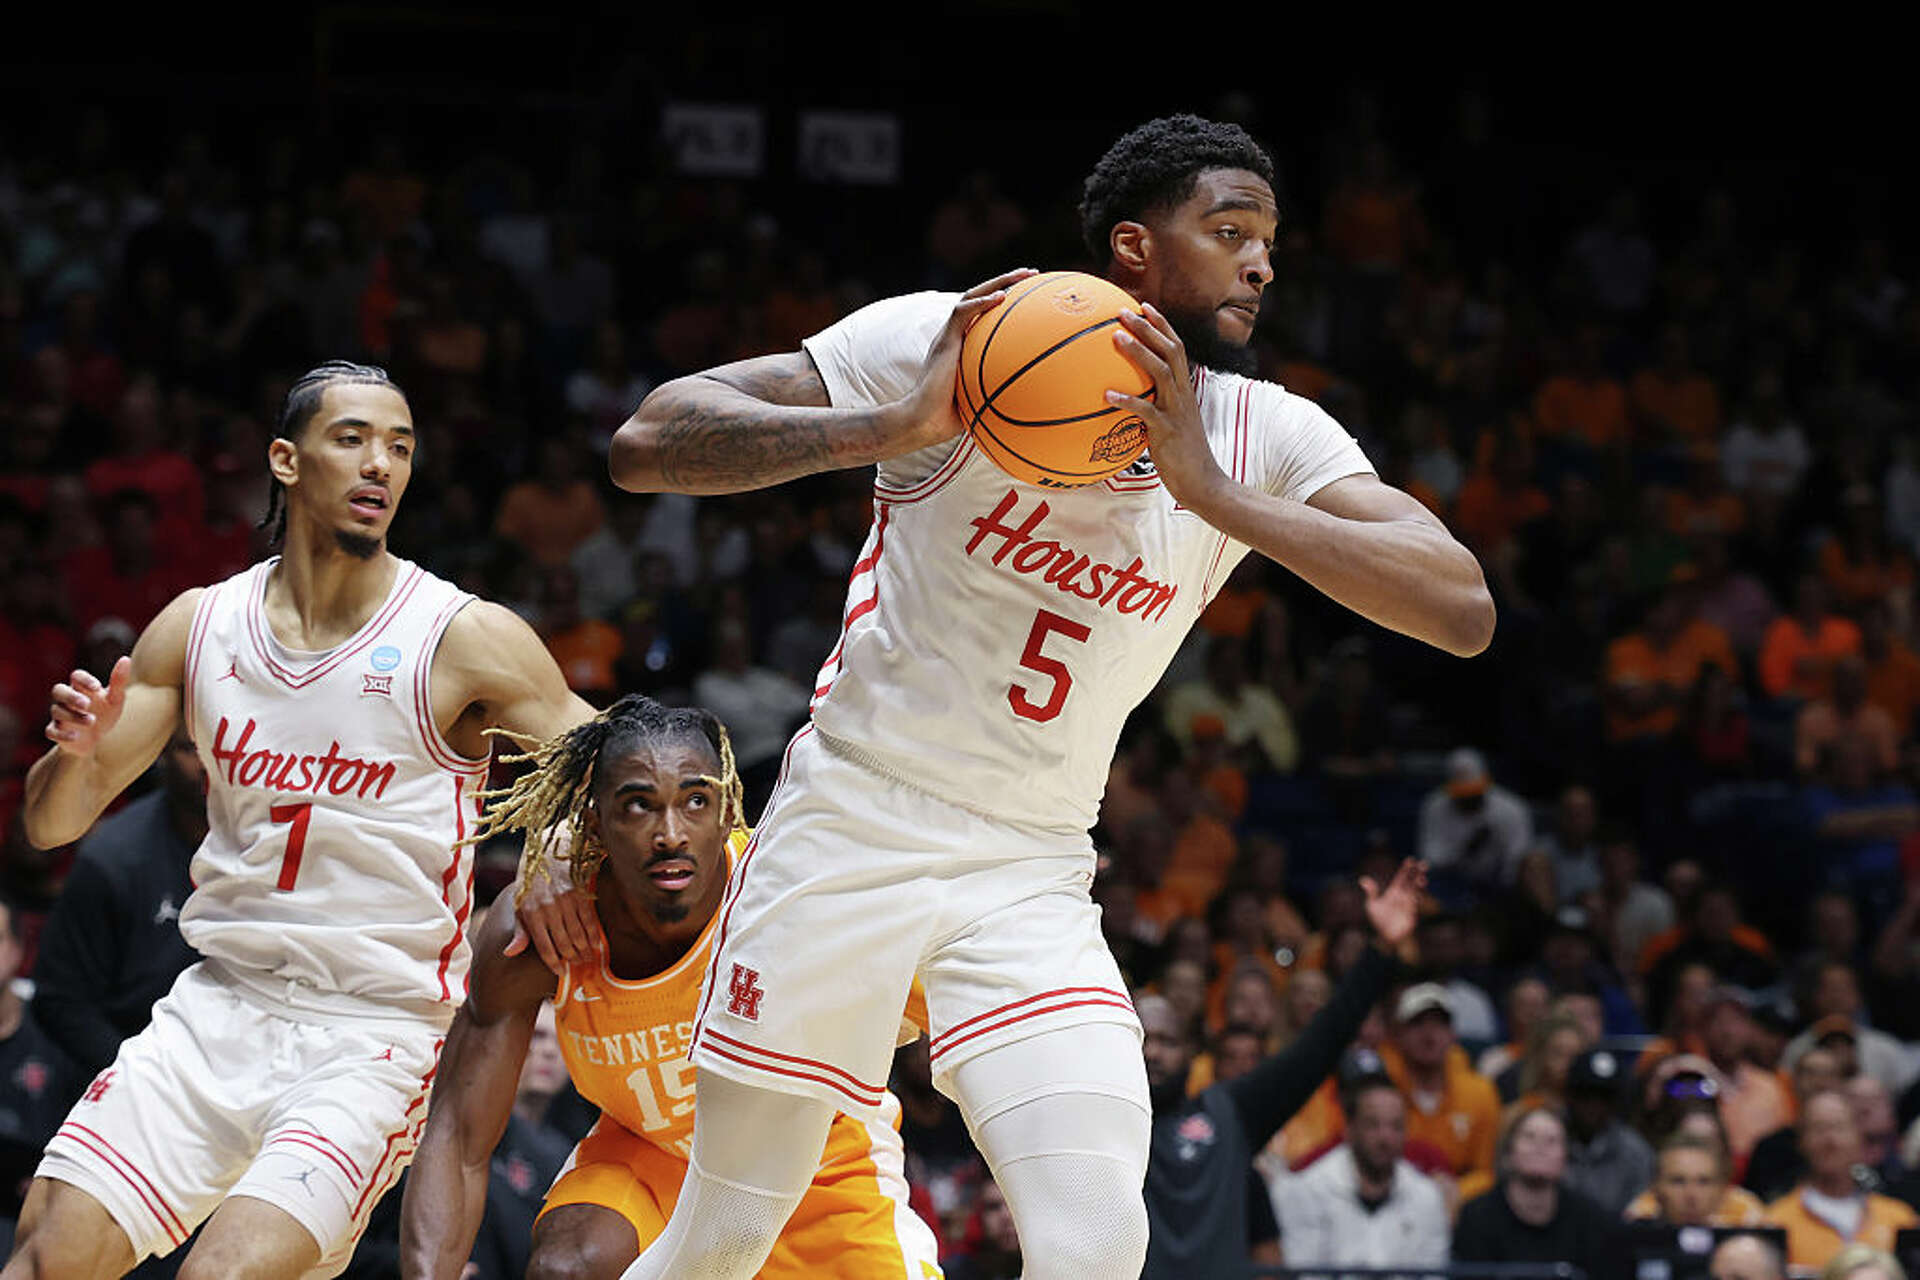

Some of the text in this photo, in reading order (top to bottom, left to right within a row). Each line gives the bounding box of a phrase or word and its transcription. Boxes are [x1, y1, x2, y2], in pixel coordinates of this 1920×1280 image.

[965, 488, 1178, 623] Houston
[1008, 608, 1092, 723] 5
[211, 716, 396, 799] Houston
[626, 1056, 697, 1132] 15
